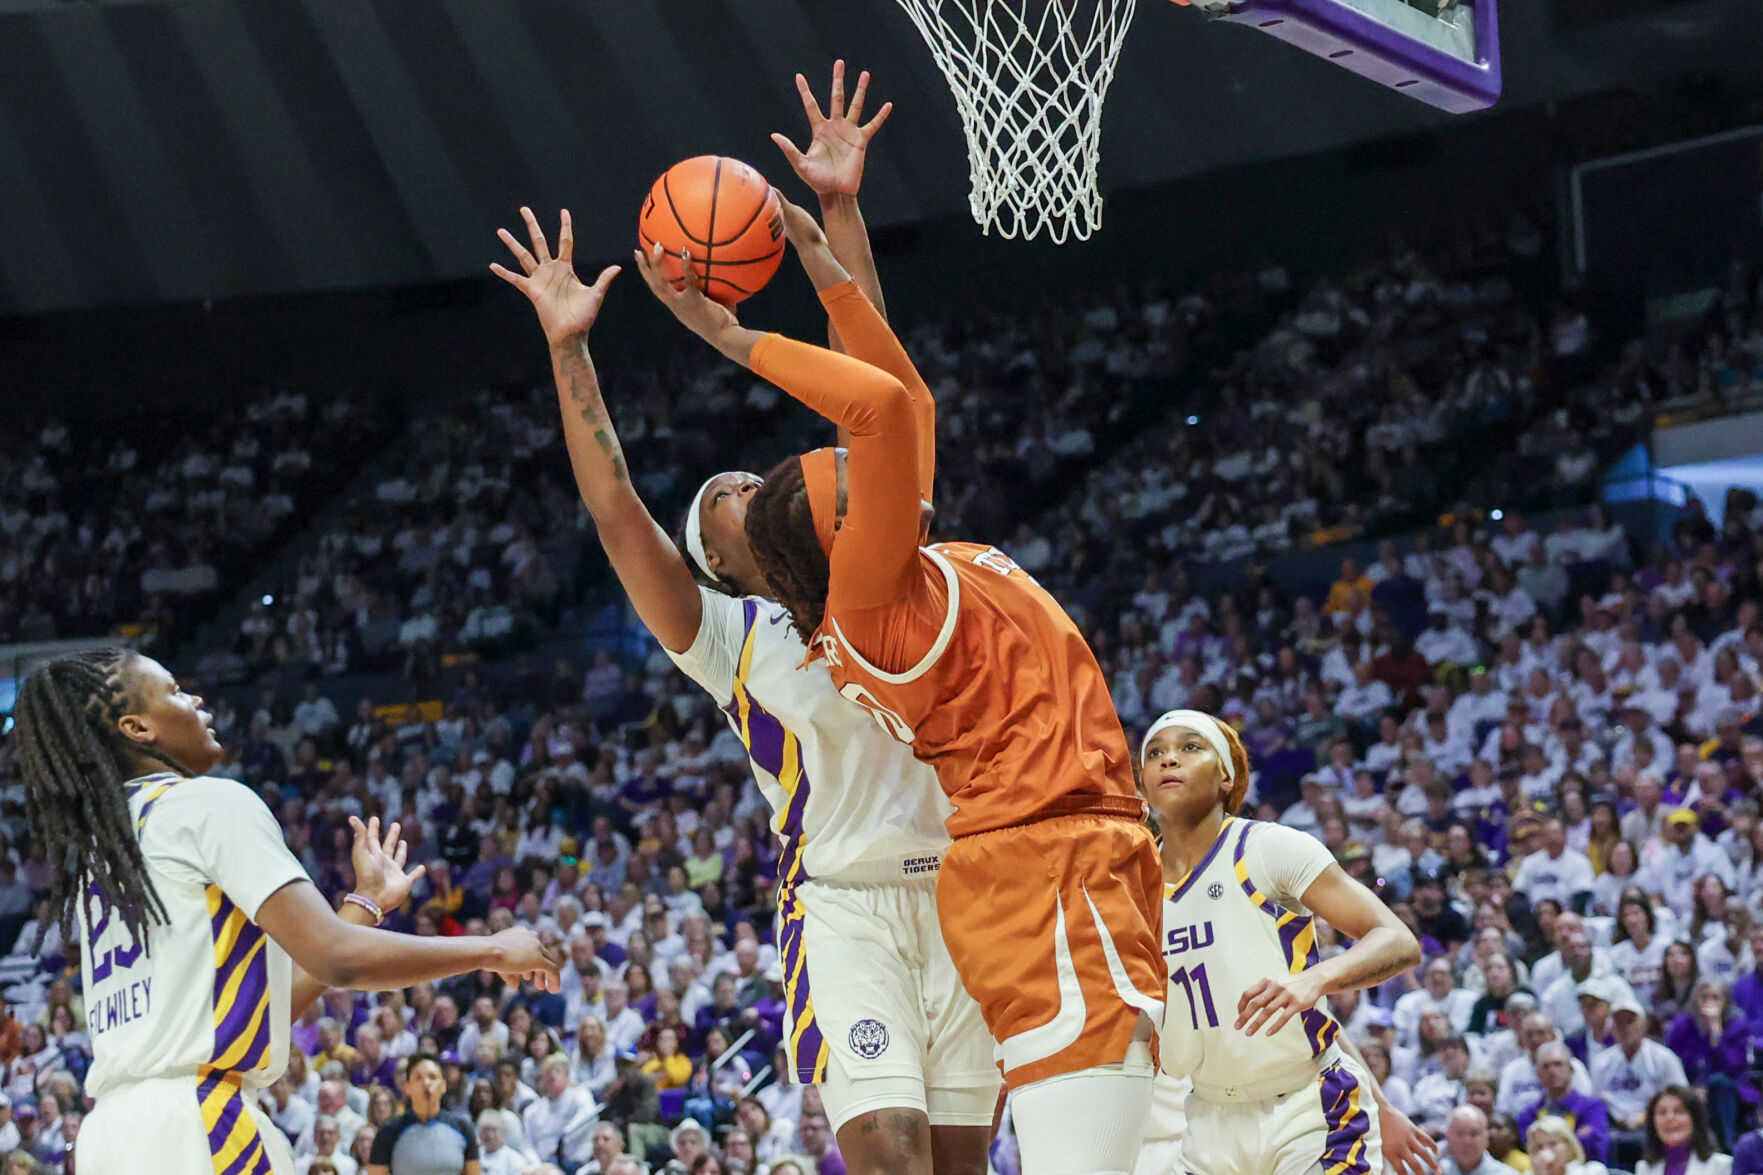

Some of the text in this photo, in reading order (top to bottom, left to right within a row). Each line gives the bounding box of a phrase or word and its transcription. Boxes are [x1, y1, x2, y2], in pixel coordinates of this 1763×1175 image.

[1209, 883, 1222, 898] SEC
[1162, 920, 1214, 956] SU
[1170, 961, 1220, 1031] 11
